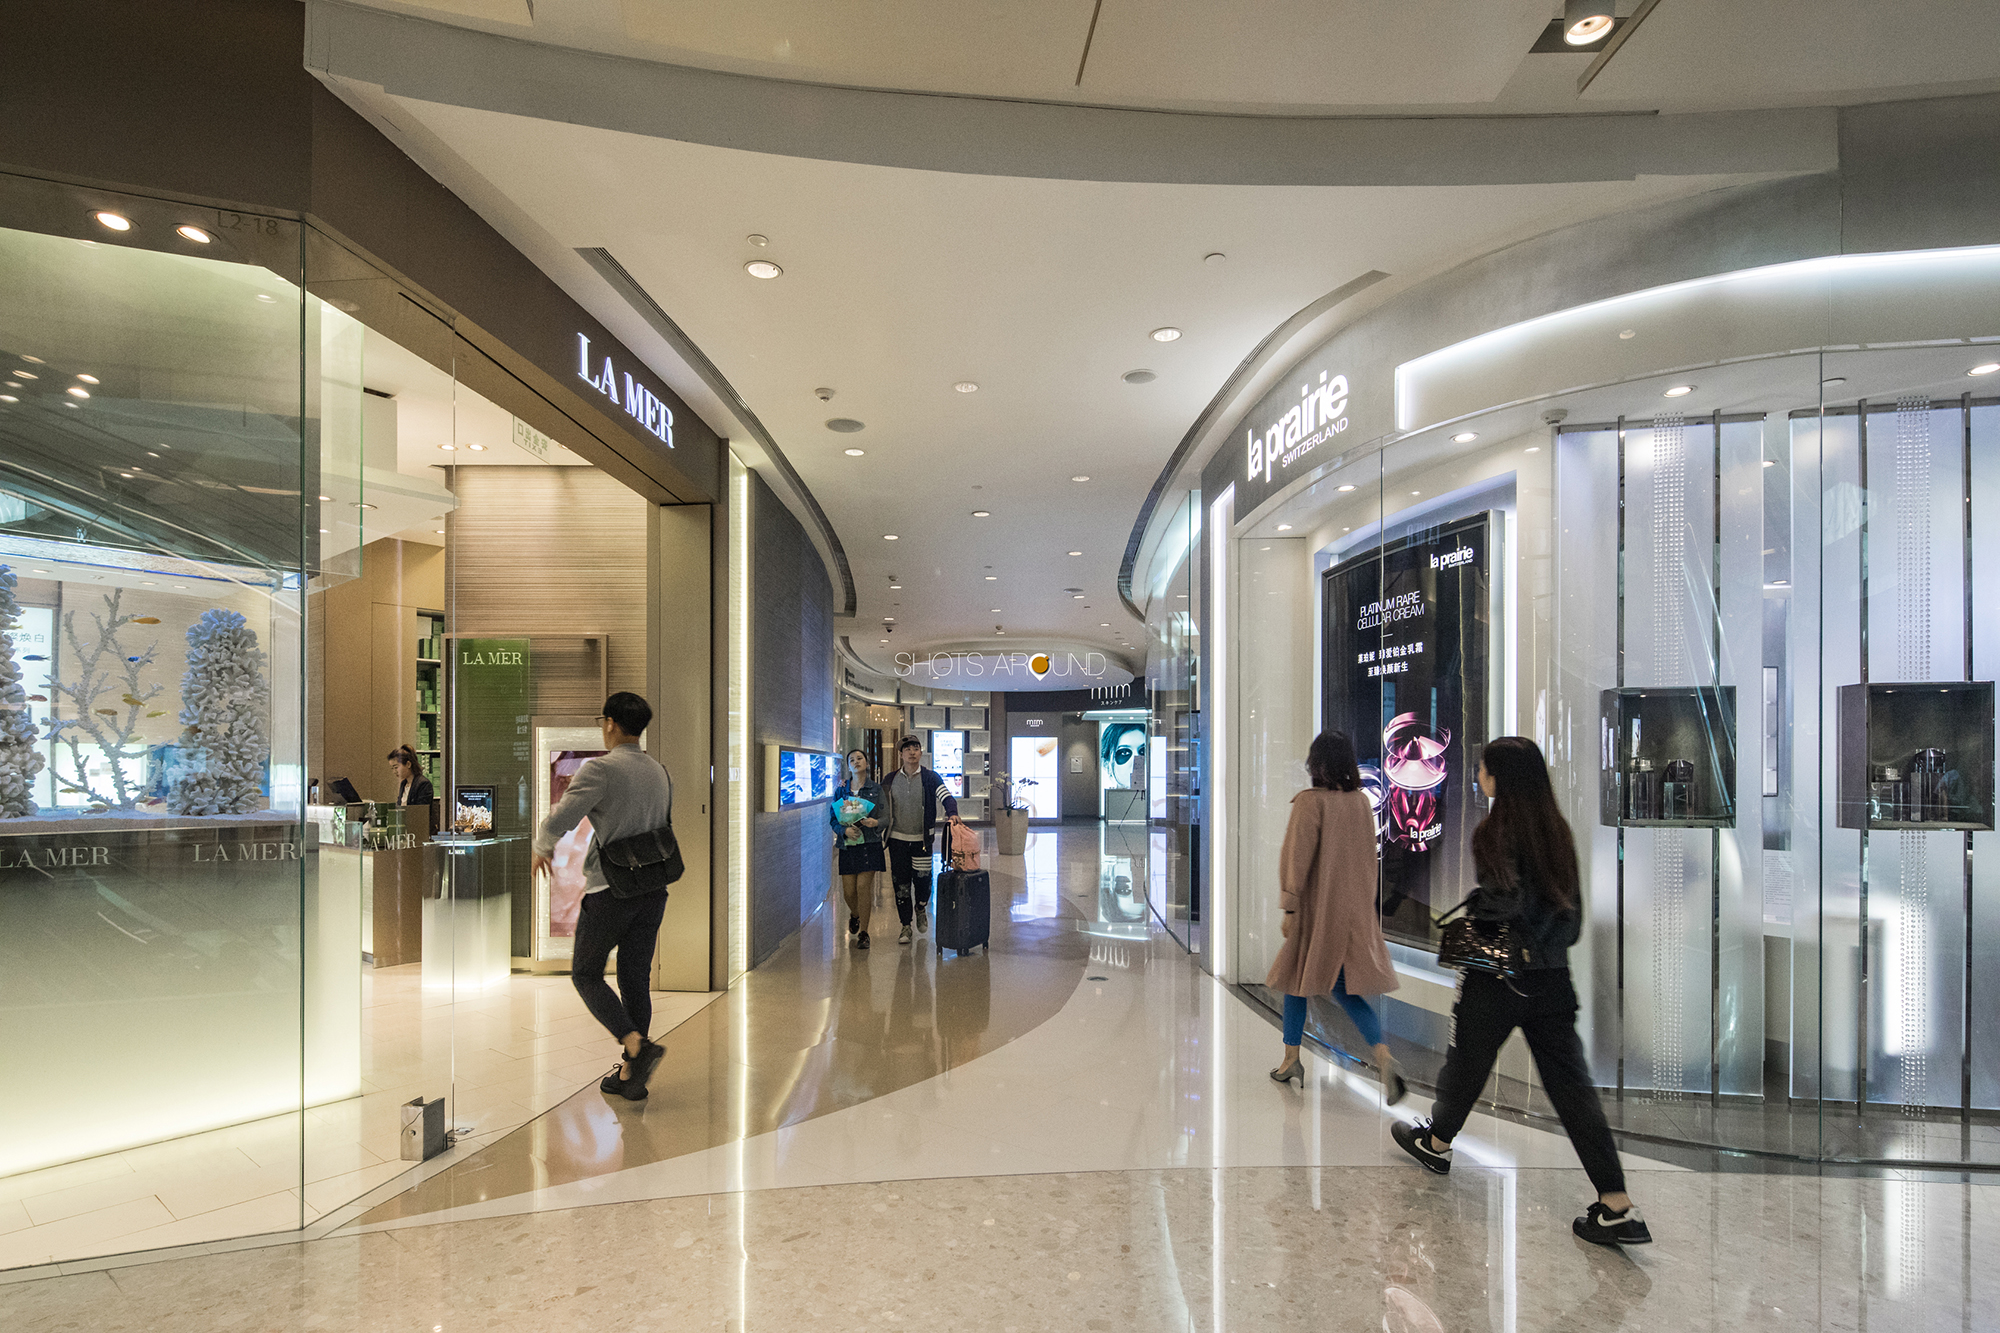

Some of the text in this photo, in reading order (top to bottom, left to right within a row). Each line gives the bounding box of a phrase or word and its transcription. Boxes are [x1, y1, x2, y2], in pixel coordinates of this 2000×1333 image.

[217, 211, 278, 235] L2-18
[577, 332, 675, 449] LA MER
[1247, 369, 1349, 483] la prairie
[1282, 416, 1349, 468] SWITZERLAND
[1430, 545, 1474, 571] la prairie
[1356, 602, 1425, 631] CELLULAR CREAM
[1359, 590, 1421, 618] PLATINUM RARE
[462, 652, 523, 665] LA MER
[383, 832, 417, 851] MER
[1410, 826, 1418, 839] la
[1419, 823, 1442, 842] prairie
[0, 846, 111, 868] LA MER
[192, 842, 299, 862] LA MER
